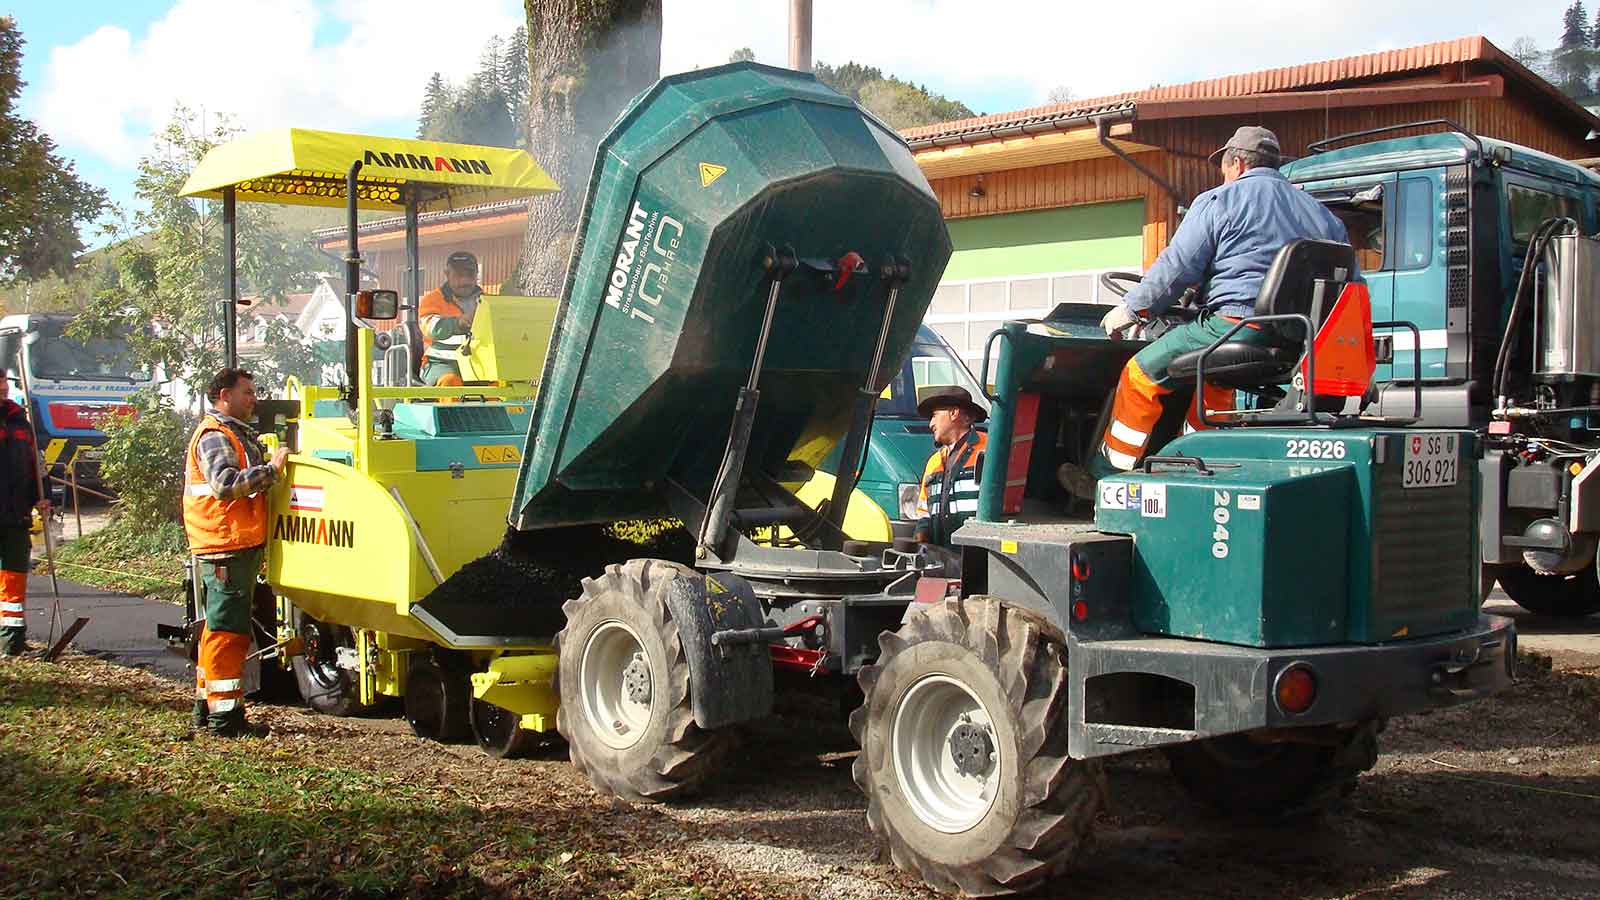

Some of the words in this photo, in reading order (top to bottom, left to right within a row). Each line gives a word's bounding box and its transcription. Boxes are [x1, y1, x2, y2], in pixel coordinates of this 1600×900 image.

[364, 150, 492, 175] AMMANN
[605, 200, 649, 309] MORANT
[622, 264, 642, 314] Strassenbau
[1286, 440, 1346, 459] 22626
[1427, 436, 1441, 455] SG
[1406, 459, 1431, 485] 306
[1435, 457, 1456, 483] 921
[1103, 486, 1124, 505] CE
[1144, 498, 1159, 514] 100
[273, 514, 354, 548] AMMANN
[1212, 489, 1230, 559] 2040
